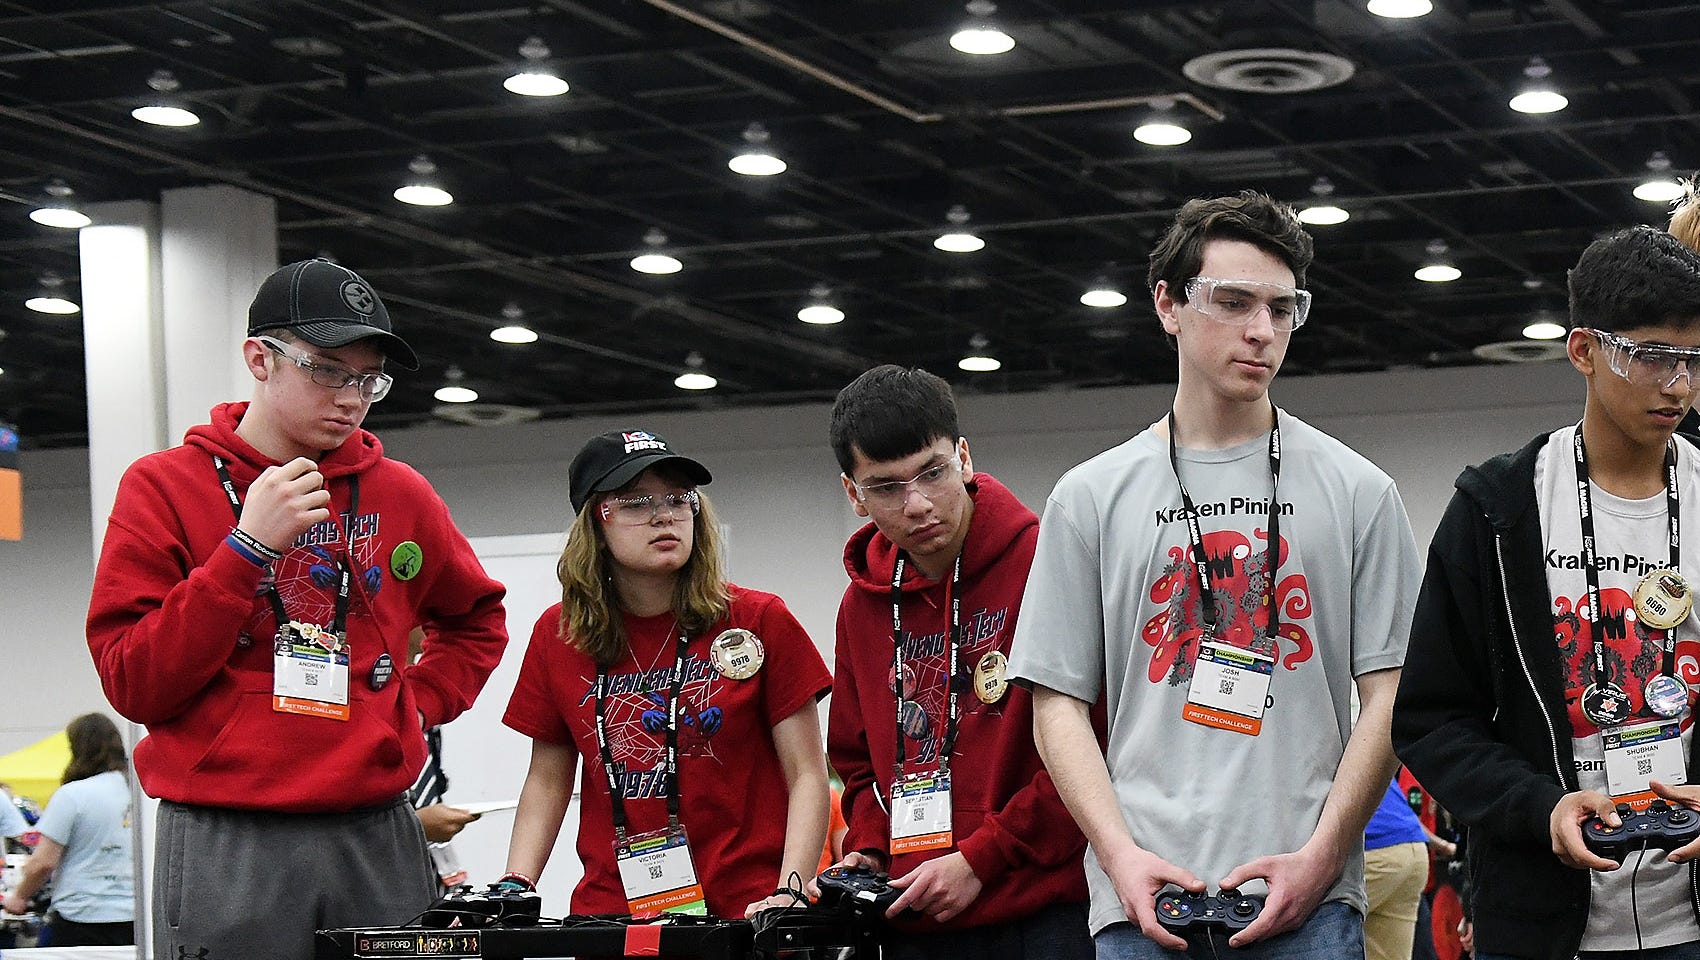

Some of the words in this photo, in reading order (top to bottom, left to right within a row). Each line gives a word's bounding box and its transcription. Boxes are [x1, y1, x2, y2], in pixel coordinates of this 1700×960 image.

[624, 440, 667, 454] FIRST
[1230, 497, 1294, 516] Pinin
[1580, 491, 1590, 518] MAGNA
[1589, 594, 1599, 623] MAGNA
[1645, 596, 1667, 616] 8680
[730, 654, 751, 668] 9978
[1221, 667, 1240, 676] JOSH
[1188, 711, 1204, 719] FIRST
[1204, 714, 1219, 722] TECH
[1218, 718, 1253, 730] CHALLENGE
[1621, 727, 1660, 740] CHAMPIONSHIP
[1605, 741, 1621, 750] FIRST
[1626, 744, 1659, 756] SHUBHAN
[1574, 760, 1605, 773] eam
[639, 852, 667, 863] VICTORIA
[649, 900, 665, 908] TECH
[665, 891, 697, 903] CHALLENGE
[372, 940, 411, 950] BRETFORD
